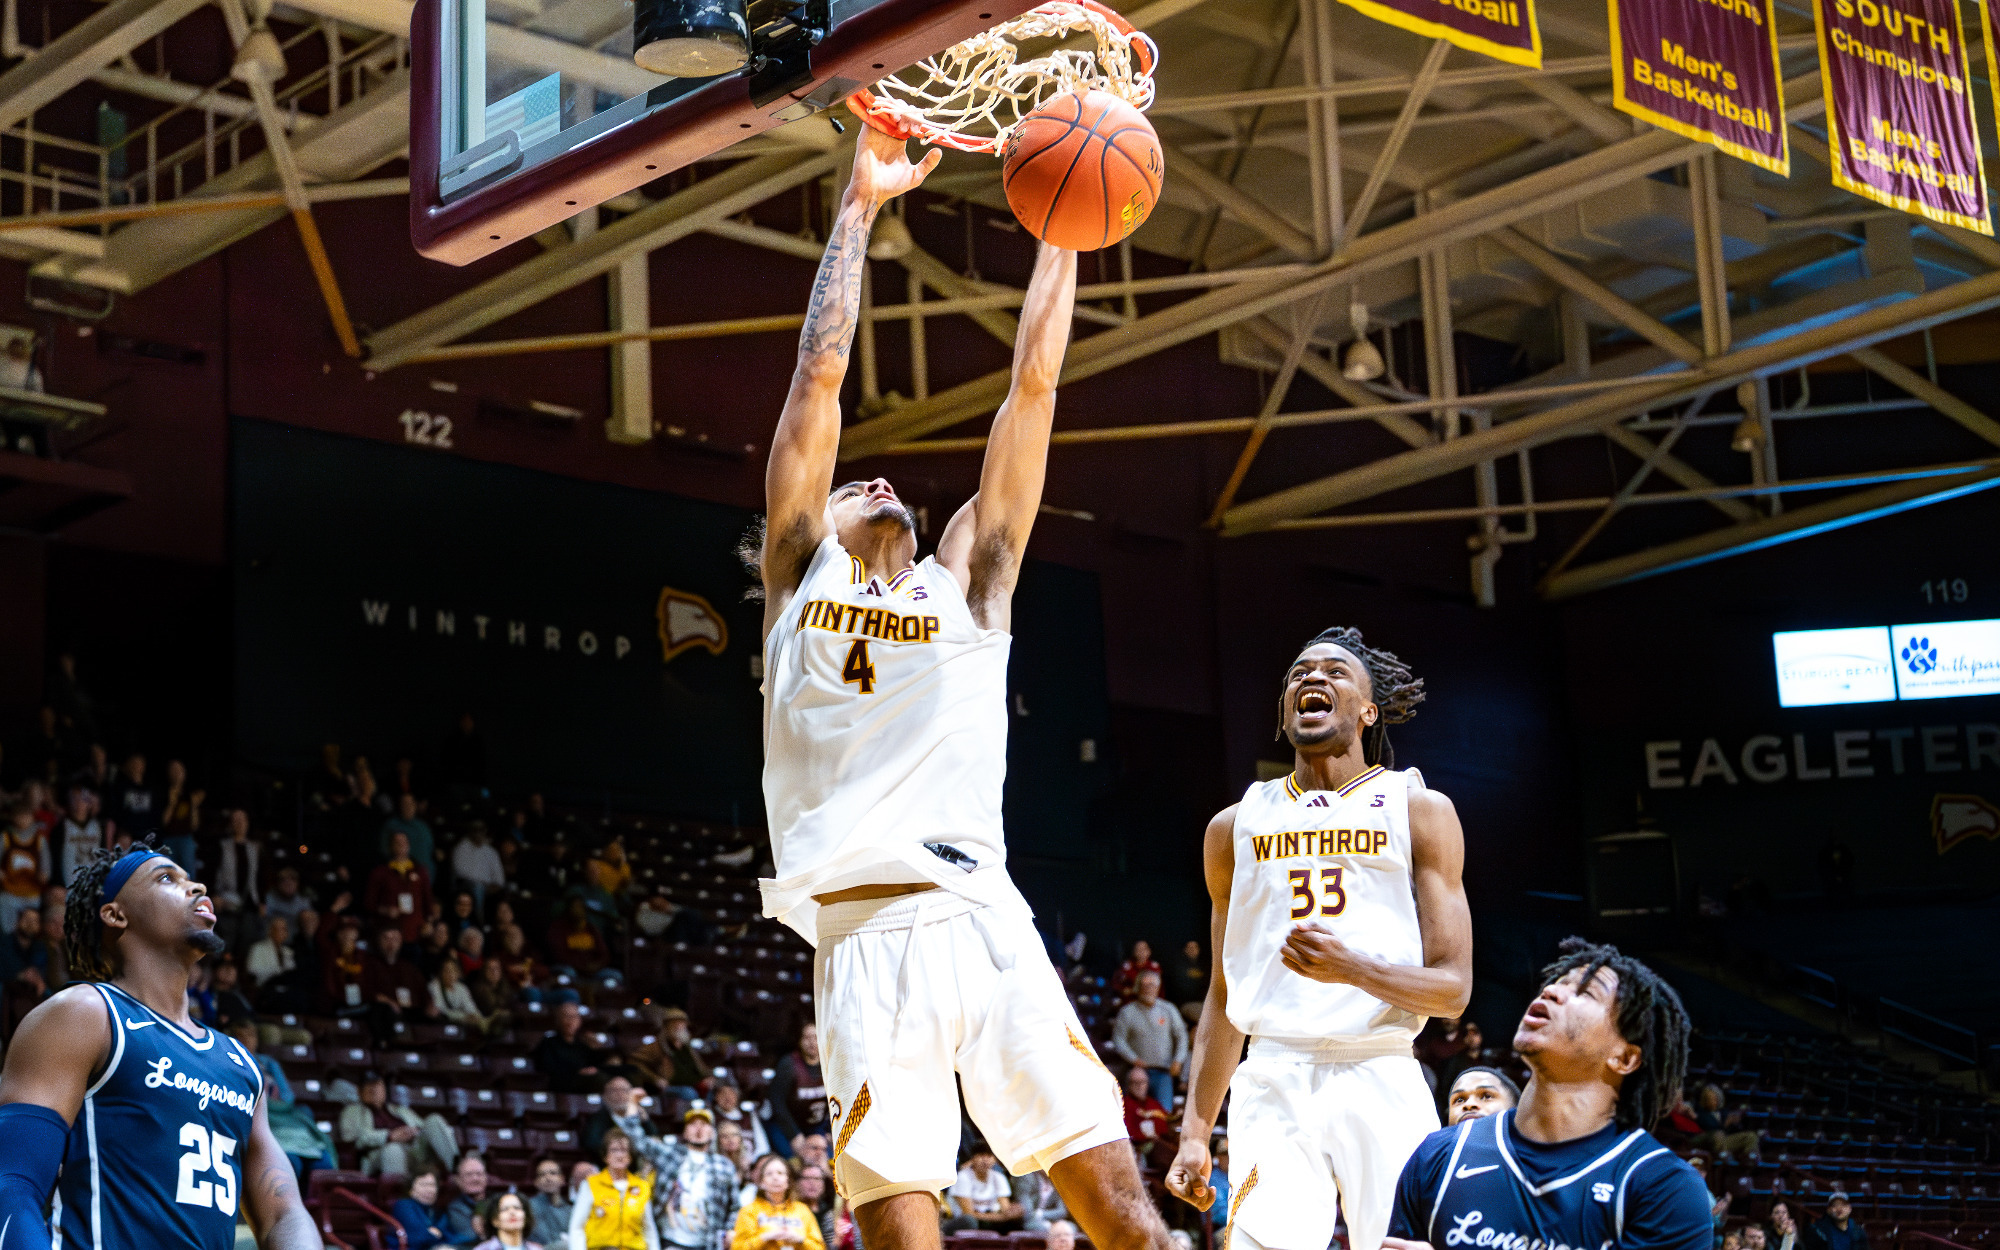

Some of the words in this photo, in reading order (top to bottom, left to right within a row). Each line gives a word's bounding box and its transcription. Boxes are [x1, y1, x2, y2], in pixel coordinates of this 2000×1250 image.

[1835, 0, 1951, 54] SOUTH
[1661, 37, 1738, 91] Men's
[1831, 27, 1963, 94] Champions
[1633, 57, 1773, 134] Basketball
[1872, 116, 1941, 158] Men's
[1849, 136, 1976, 197] Basketball
[400, 409, 454, 448] 122
[1921, 579, 1968, 604] 119
[361, 598, 632, 660] WINTHROP
[841, 639, 876, 695] 4
[1251, 829, 1388, 863] WINTHROP
[1288, 867, 1347, 921] 33
[144, 1056, 254, 1117] Longwood
[175, 1122, 238, 1217] 25
